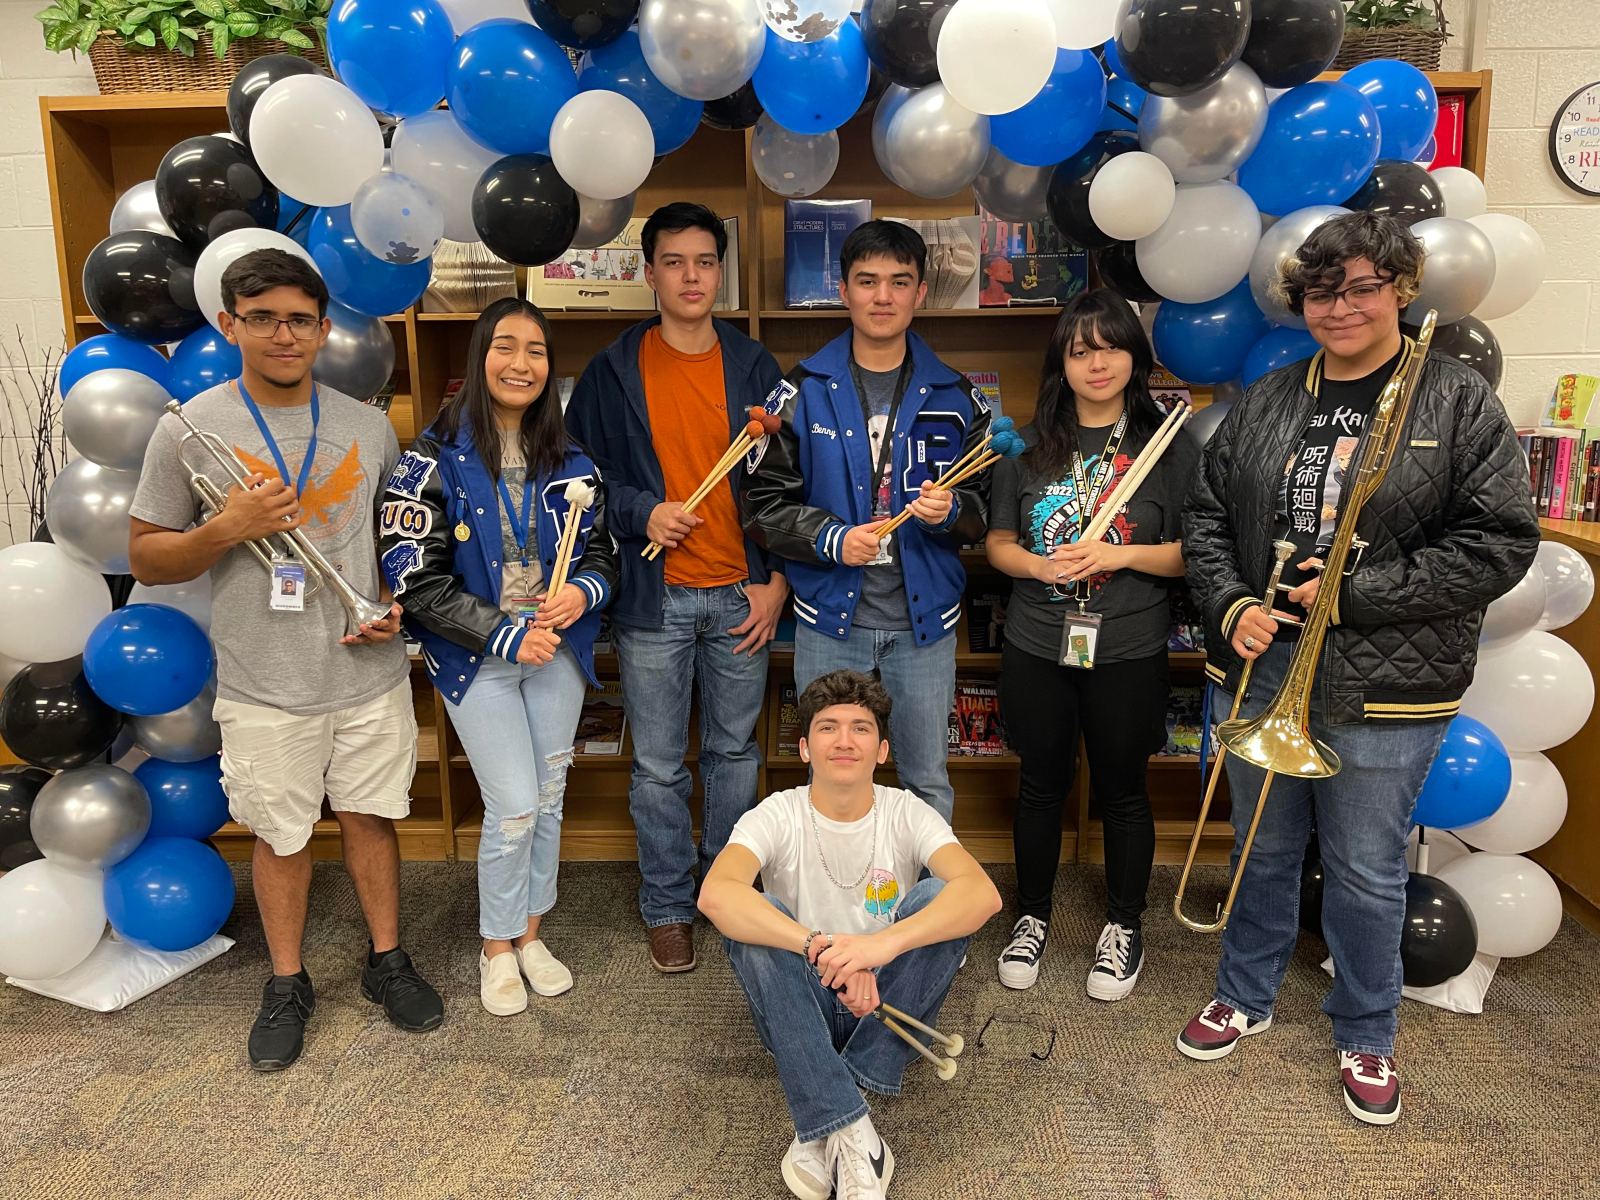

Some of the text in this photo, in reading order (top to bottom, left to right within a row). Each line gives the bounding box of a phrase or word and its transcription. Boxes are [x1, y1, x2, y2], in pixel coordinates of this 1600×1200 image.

[1587, 97, 1596, 105] 11
[1571, 113, 1580, 121] 10
[1564, 134, 1572, 143] 9
[1568, 155, 1575, 163] 8
[1582, 171, 1588, 180] 7
[812, 423, 836, 439] Benny
[1046, 486, 1073, 496] 2022
[1292, 446, 1328, 534] 呪術廻戦
[381, 503, 427, 534] UCO
[1043, 512, 1066, 553] REGION
